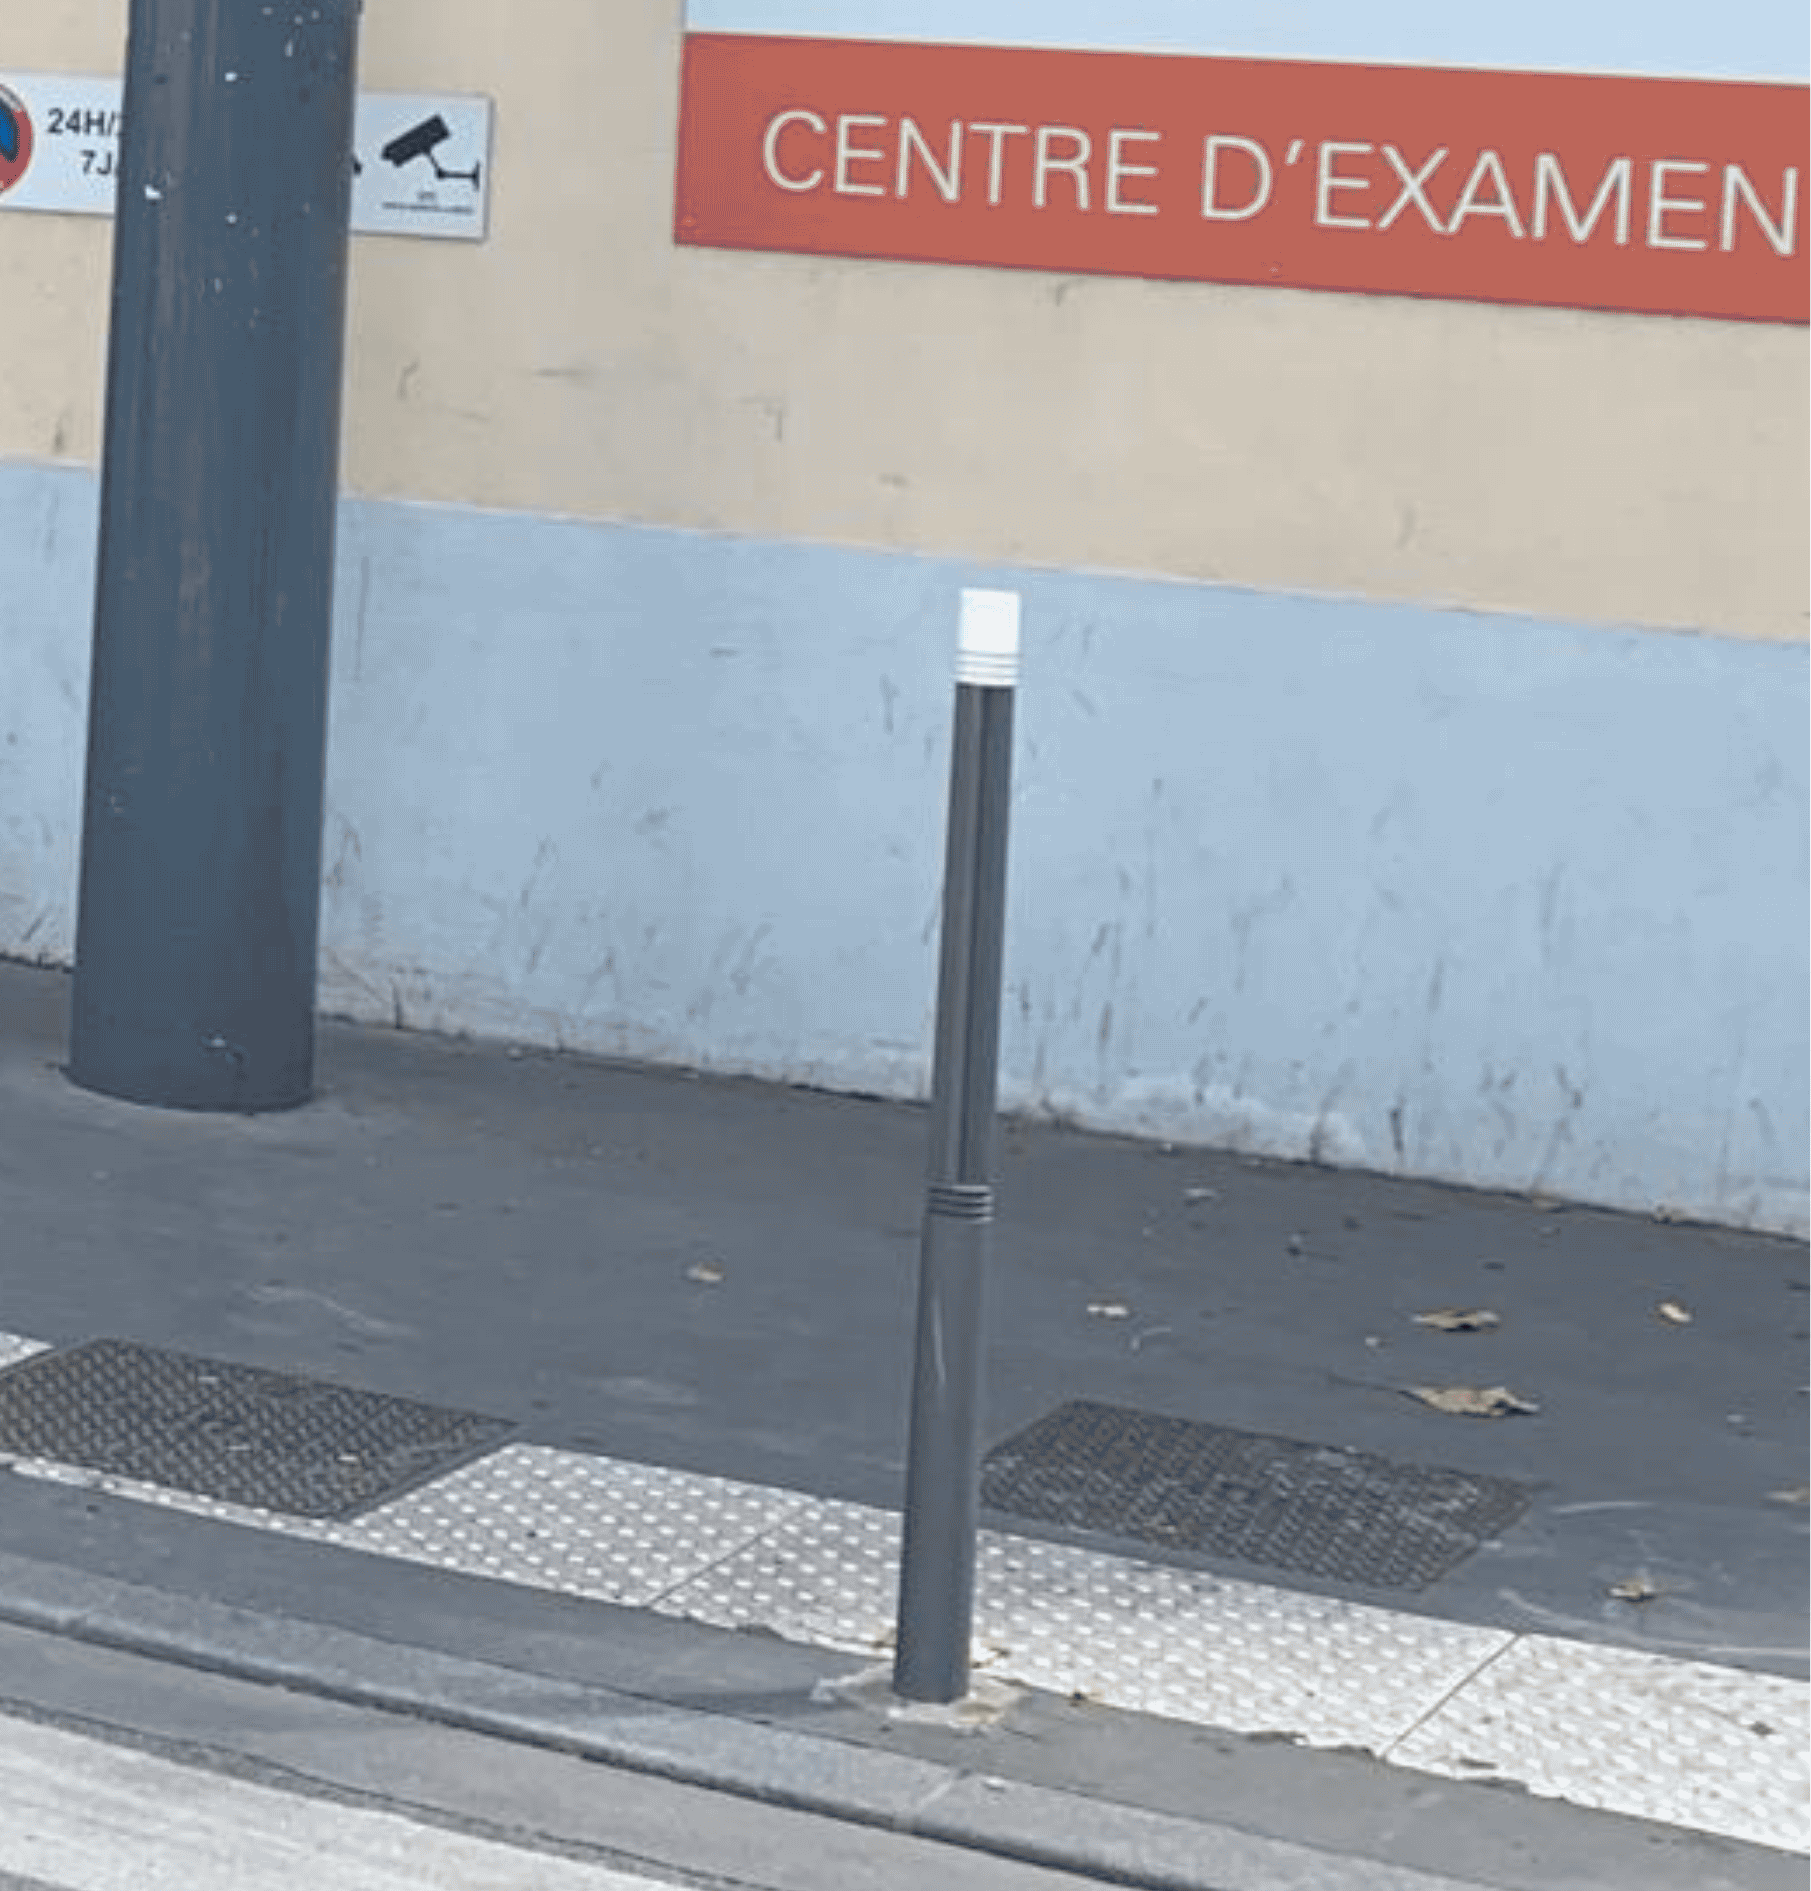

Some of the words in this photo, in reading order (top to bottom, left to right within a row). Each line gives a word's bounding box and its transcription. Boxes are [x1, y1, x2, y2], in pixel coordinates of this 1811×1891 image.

[47, 107, 122, 136] 24H/
[80, 149, 113, 176] 7J
[763, 109, 1162, 215] CENTRE
[1200, 134, 1798, 256] D'EXAMEN
